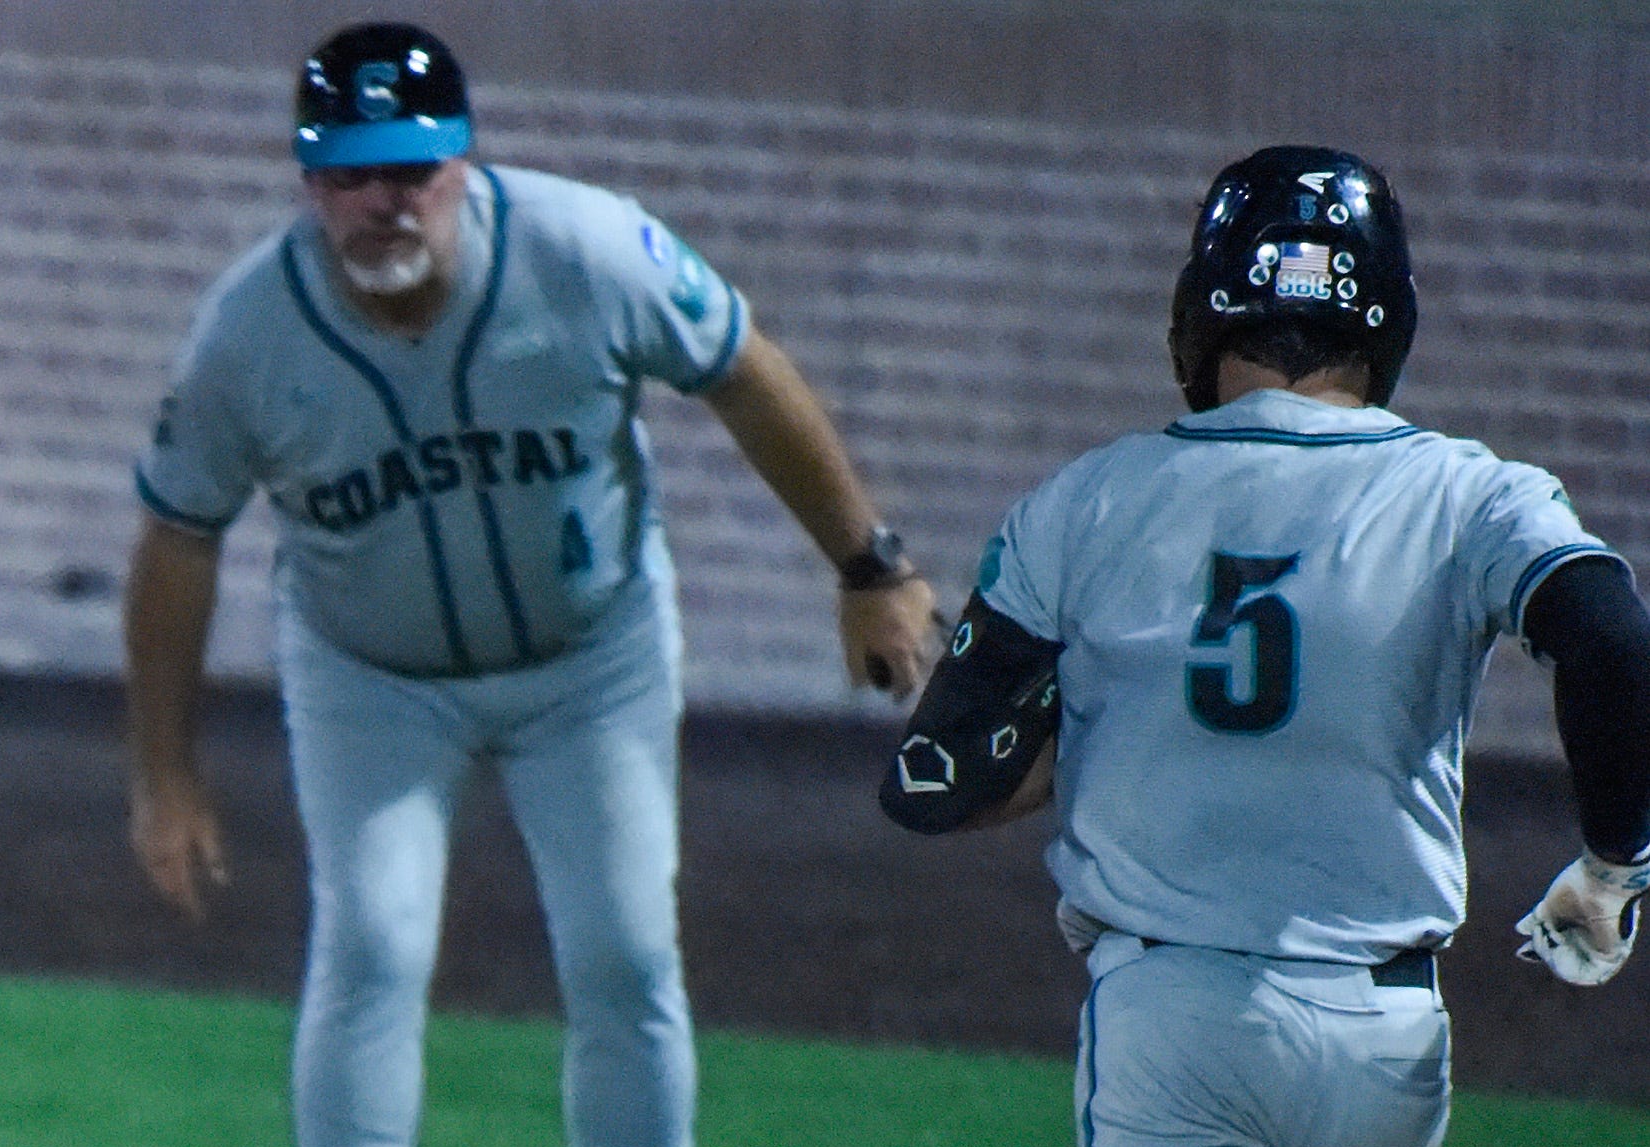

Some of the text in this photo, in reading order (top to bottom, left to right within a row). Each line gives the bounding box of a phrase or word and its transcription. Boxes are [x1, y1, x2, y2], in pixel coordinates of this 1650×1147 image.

[1276, 271, 1332, 300] SBC
[304, 427, 591, 536] COASTAL
[1184, 550, 1300, 736] 5
